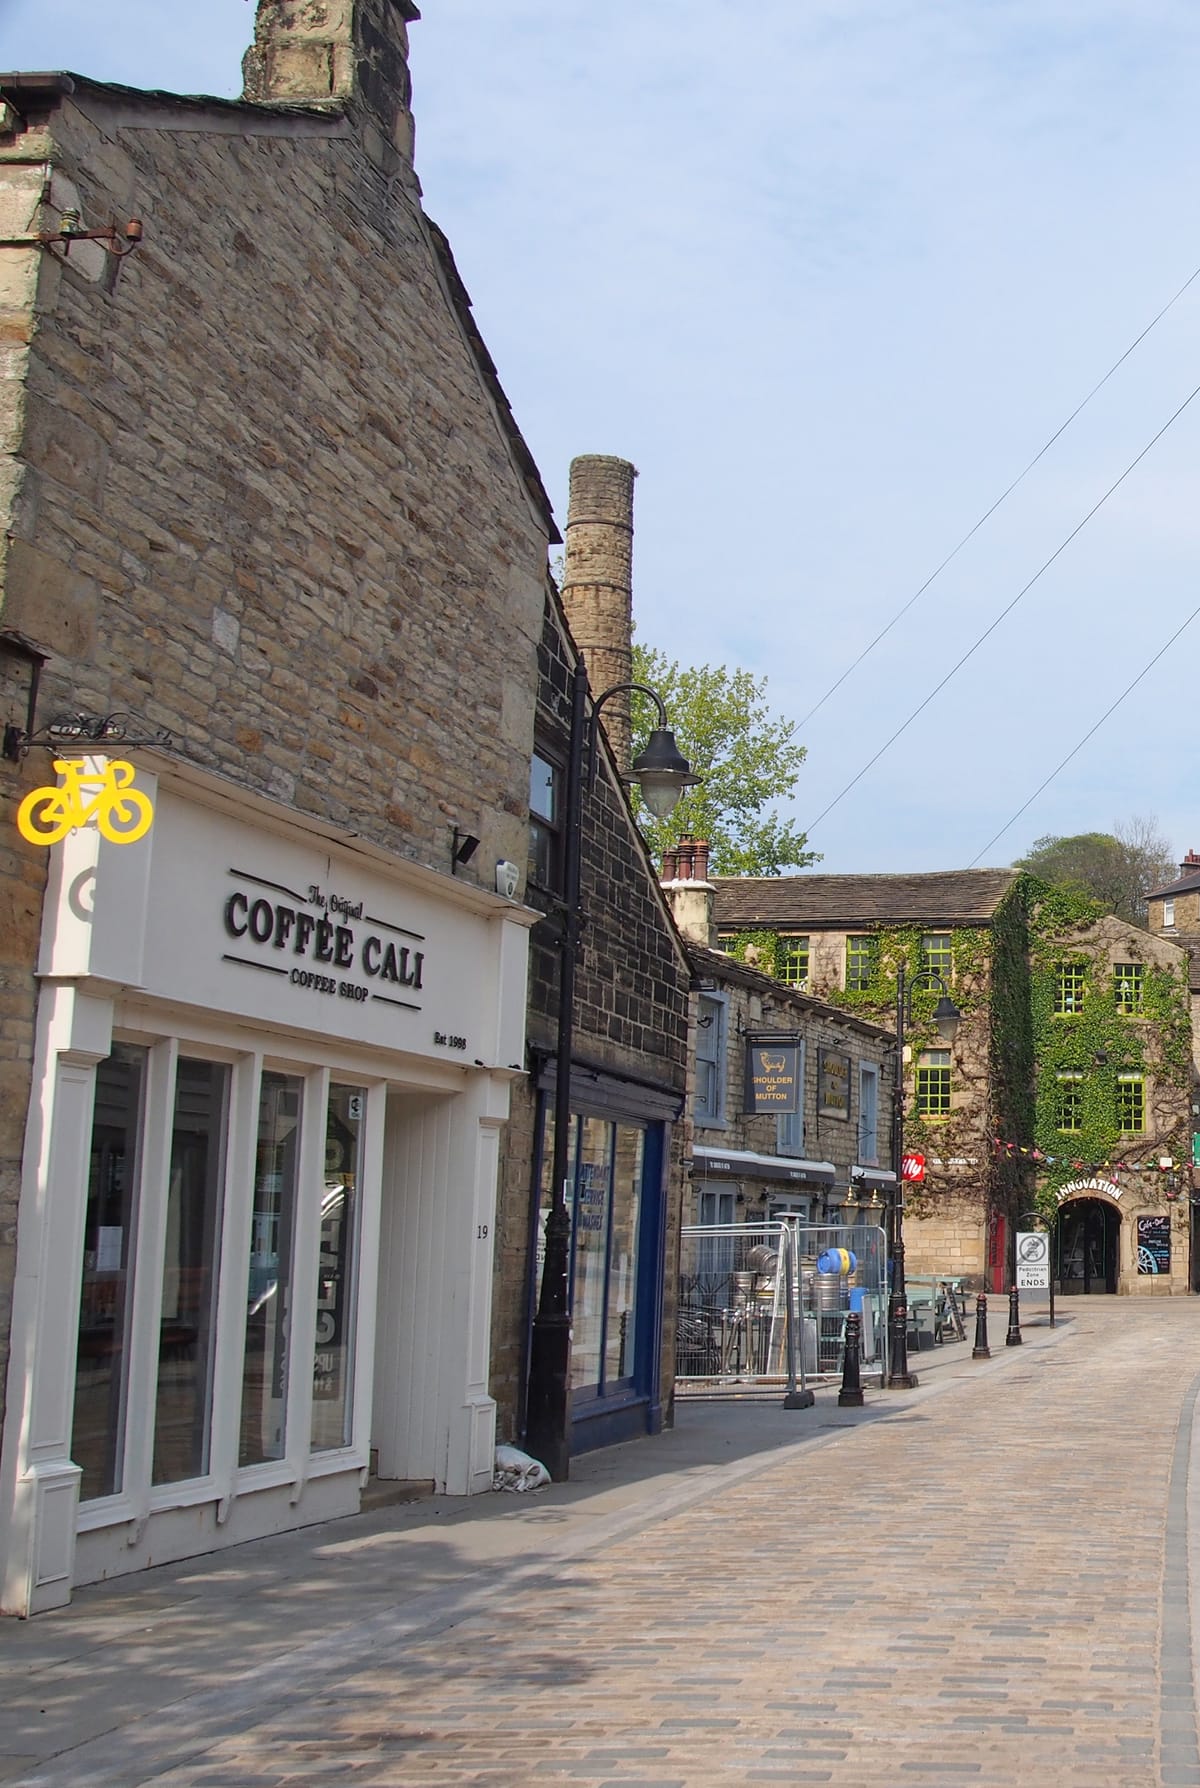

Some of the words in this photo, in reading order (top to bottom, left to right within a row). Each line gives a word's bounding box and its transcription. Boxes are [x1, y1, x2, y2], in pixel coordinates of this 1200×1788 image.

[308, 885, 326, 908] The
[330, 894, 364, 924] Original
[226, 892, 354, 969] COFFEE
[361, 936, 425, 990] CALI
[290, 968, 336, 995] COFFEE
[339, 981, 369, 1003] SHOP
[434, 1031, 447, 1047] Est
[752, 1076, 793, 1084] SHOULDER
[755, 1093, 787, 1101] MUTTON
[766, 1085, 777, 1093] OF
[902, 1158, 922, 1178] illy
[1055, 1177, 1123, 1200] INNOVATION
[477, 1225, 488, 1239] 19
[1021, 1279, 1045, 1287] ENDS
